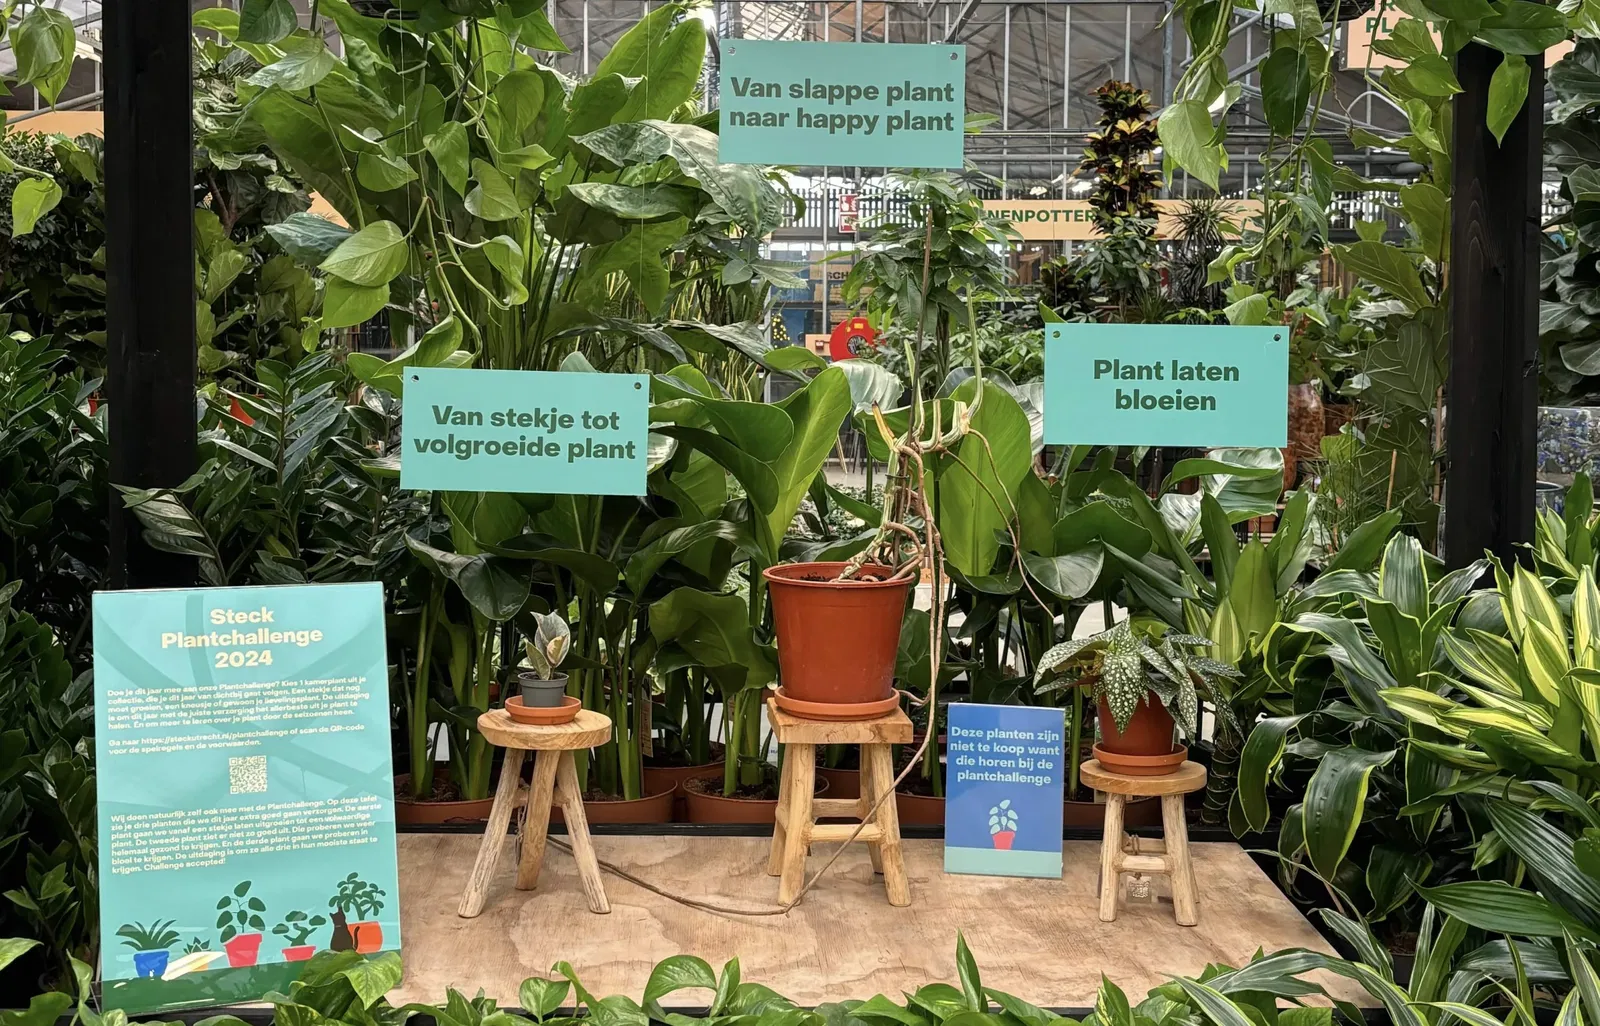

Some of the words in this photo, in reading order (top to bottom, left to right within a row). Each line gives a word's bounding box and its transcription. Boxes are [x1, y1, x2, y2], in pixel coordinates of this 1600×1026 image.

[730, 76, 782, 98] Van
[788, 78, 880, 106] slappe
[886, 80, 954, 107] plant
[730, 110, 790, 127] naar
[796, 107, 880, 136] happy
[886, 109, 954, 136] plant
[1093, 359, 1164, 381] Plant
[1171, 359, 1240, 382] laten
[1115, 388, 1216, 411] bloeien
[431, 405, 483, 426] Van
[490, 407, 575, 434] stekje
[581, 410, 620, 431] tot
[413, 433, 561, 461] volgroeide
[567, 437, 636, 463] plant
[210, 607, 275, 625] Steck
[161, 627, 323, 649] Plantchallenge
[214, 649, 273, 668] 2024
[107, 689, 124, 697] Doe
[147, 687, 162, 696] jaar
[281, 679, 297, 687] Kies
[304, 676, 346, 687] kamerplant
[347, 675, 357, 683] uit
[191, 716, 212, 724] leren
[241, 713, 261, 723] plant
[262, 712, 280, 720] door
[294, 709, 332, 718] seizoenen
[329, 723, 364, 732] QR-code
[951, 726, 984, 737] Deze
[986, 727, 1035, 741] planten
[1037, 730, 1060, 743] zijn
[141, 743, 183, 754] spelregels
[950, 740, 975, 752] niet
[978, 742, 990, 752] te
[993, 742, 1025, 755] koop
[1027, 745, 1060, 755] want
[955, 755, 976, 766] die
[978, 756, 1015, 768] horen
[1018, 757, 1034, 771] bij
[1037, 758, 1054, 770] de
[957, 770, 1052, 786] plantchallenge
[110, 815, 124, 824] Wij
[126, 813, 147, 821] doen
[148, 810, 185, 821] natuurlijk
[187, 808, 201, 816] zelf
[203, 807, 218, 815] ook
[238, 804, 254, 812] met
[340, 795, 358, 804] deze
[360, 794, 377, 802] tafel
[111, 823, 122, 831] zie
[133, 821, 149, 829] drie
[151, 818, 181, 829] planten
[182, 817, 195, 825] die
[210, 815, 221, 823] dit
[223, 814, 237, 823] jaar
[239, 812, 260, 820] extra
[261, 810, 281, 820] goed
[283, 810, 301, 818] gaan
[357, 802, 381, 811] eerste
[111, 831, 131, 841] plant
[133, 831, 153, 839] gaan
[168, 826, 190, 835] vanaf
[208, 823, 232, 833] stekje
[234, 821, 253, 829] laten
[255, 817, 294, 829] uitgroeien
[324, 811, 370, 823] volwaardige
[149, 835, 179, 845] tweede
[181, 833, 200, 843] plant
[203, 832, 217, 840] ziet
[229, 830, 244, 838] niet
[256, 827, 276, 837] goed
[292, 825, 305, 833] Die
[306, 822, 341, 833] proberen
[111, 846, 148, 856] helemaal
[149, 844, 179, 854] gezond
[245, 836, 268, 845] derde
[270, 835, 289, 844] plant
[291, 834, 310, 843] gaan
[324, 829, 359, 840] proberen
[111, 856, 132, 864] bloei
[188, 848, 225, 860] uitdaging
[260, 844, 274, 852] alle
[275, 843, 290, 851] drie
[300, 841, 315, 849] hun
[316, 838, 347, 848] mooiste
[348, 837, 368, 845] staat
[143, 860, 184, 872] Challenge
